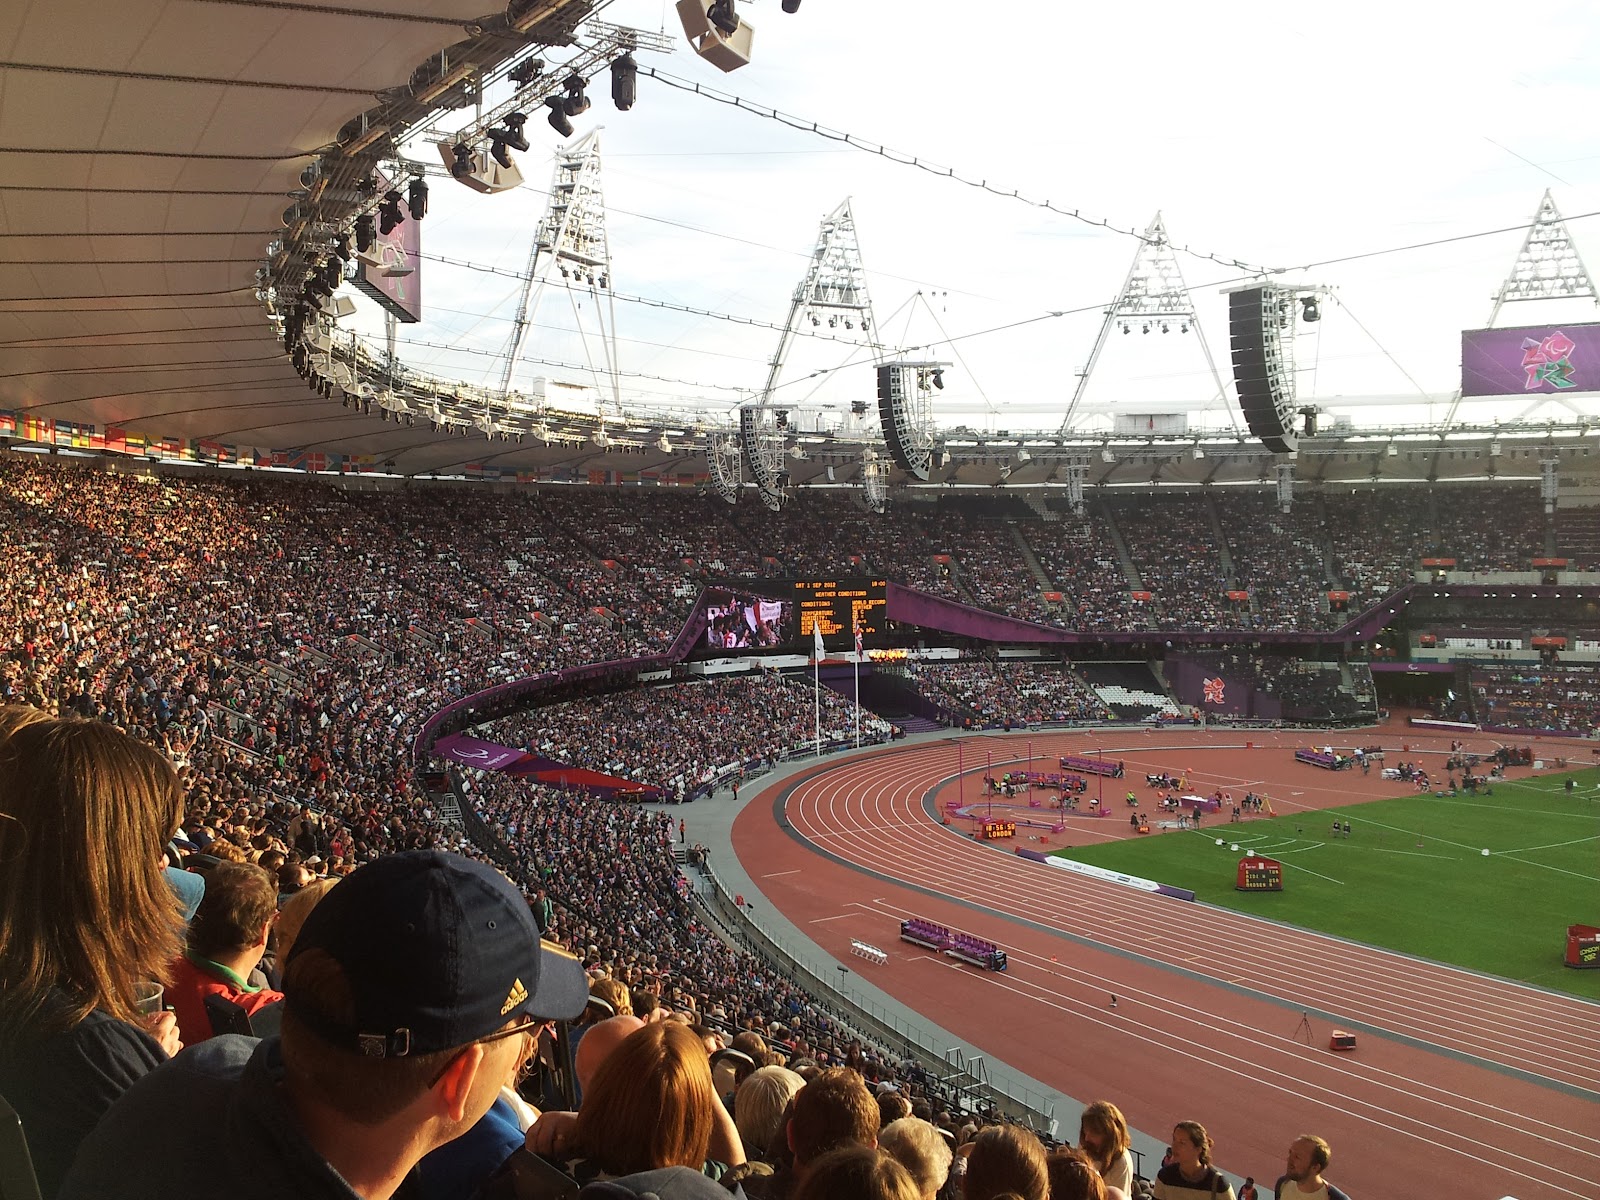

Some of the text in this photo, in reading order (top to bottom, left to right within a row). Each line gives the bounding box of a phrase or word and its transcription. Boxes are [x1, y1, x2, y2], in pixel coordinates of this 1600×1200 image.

[988, 830, 1012, 838] LONDON
[1580, 945, 1599, 956] LONDON
[500, 989, 529, 1016] adidas
